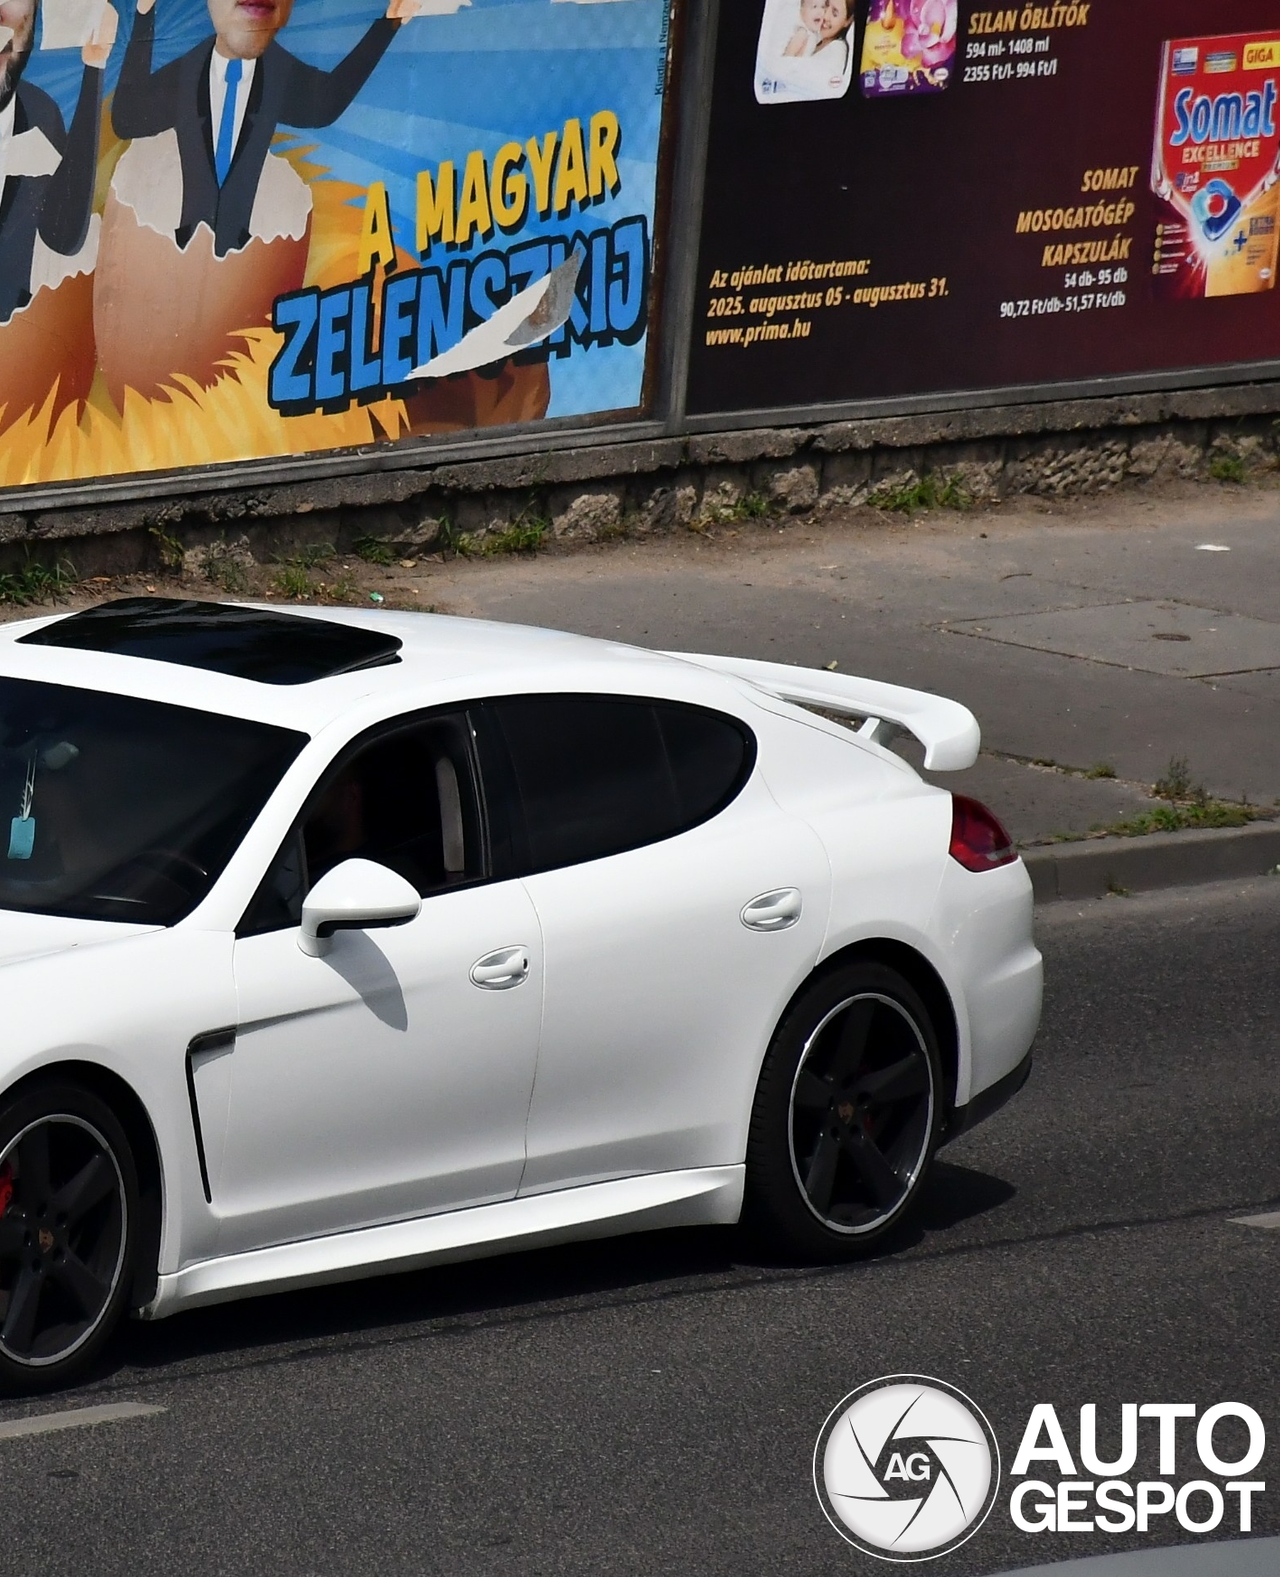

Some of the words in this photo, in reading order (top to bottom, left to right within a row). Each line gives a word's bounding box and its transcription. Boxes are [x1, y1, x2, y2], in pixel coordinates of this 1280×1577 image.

[967, 9, 1018, 35] SILAN
[965, 42, 986, 59] 594
[1008, 38, 1033, 55] 1408
[1035, 36, 1050, 53] ml
[1246, 48, 1274, 64] GIGA
[963, 65, 990, 82] 2355
[1016, 61, 1035, 78] 994
[1170, 79, 1277, 146] Somat
[1181, 140, 1260, 164] EXCELLENCE
[357, 181, 397, 274] A
[415, 110, 623, 258] MAGYAR
[1081, 166, 1139, 192] SOMAT
[1015, 196, 1135, 233] MOSOGATÓGÉP
[1041, 232, 1133, 267] KAPSZULÁK
[709, 269, 729, 289] Az
[730, 263, 783, 292] ajánlat
[784, 258, 871, 283] időtartama:
[1064, 272, 1077, 288] 54
[1098, 268, 1112, 285] 95
[1113, 266, 1128, 283] db
[706, 297, 746, 318] 2025.
[749, 290, 822, 318] augusztus
[825, 286, 843, 306] 05
[853, 281, 925, 308] augusztus
[928, 276, 950, 298] 31.
[1000, 300, 1030, 318] 90,72
[1095, 290, 1126, 309] Ft/db
[705, 317, 812, 348] www.prima.hu
